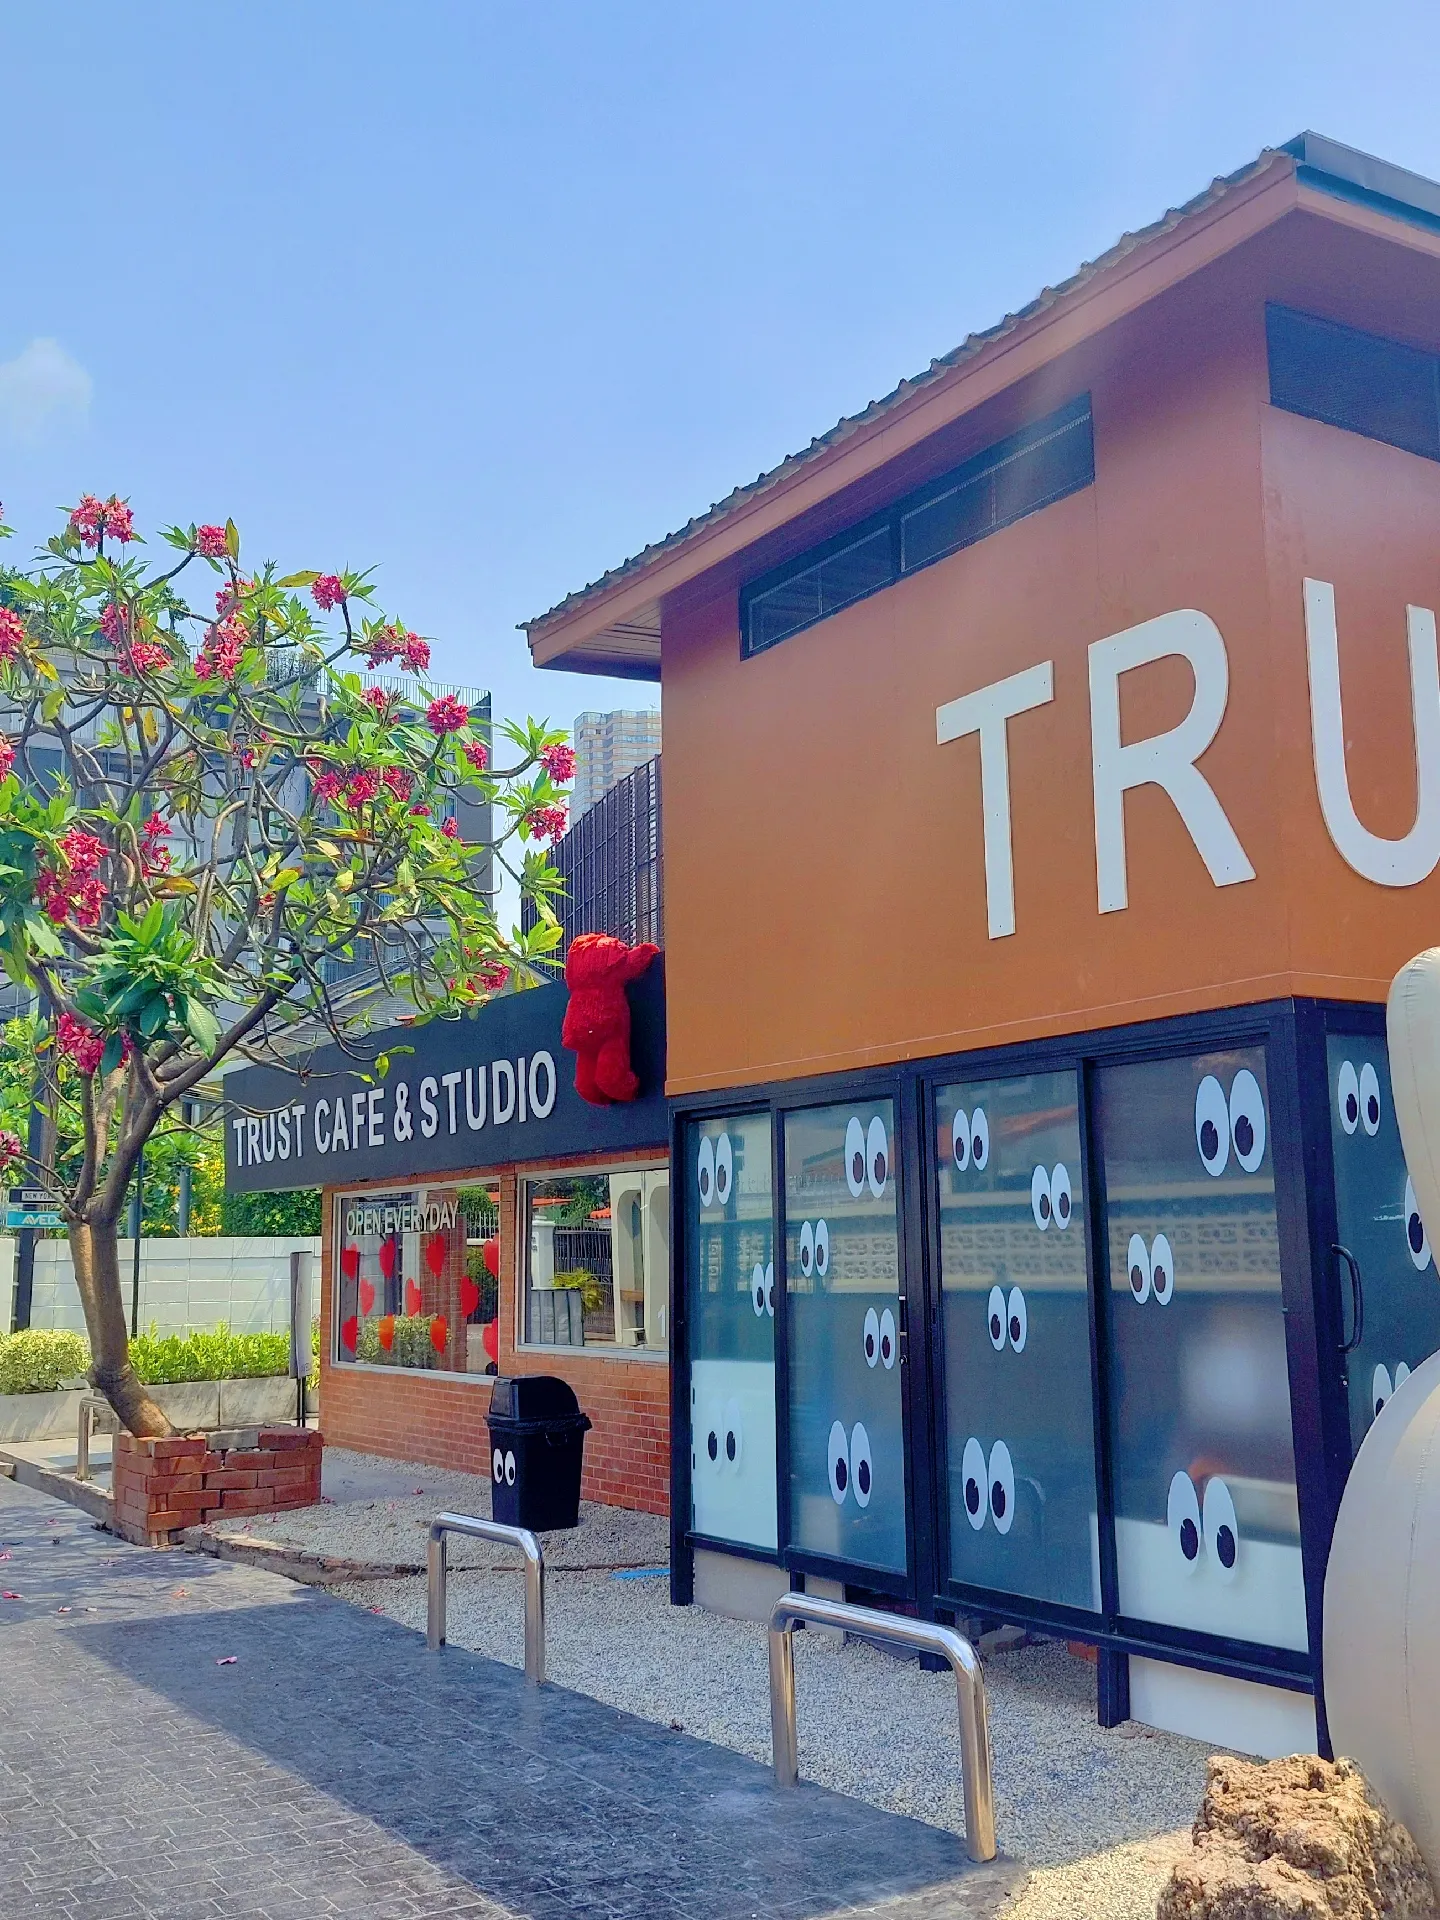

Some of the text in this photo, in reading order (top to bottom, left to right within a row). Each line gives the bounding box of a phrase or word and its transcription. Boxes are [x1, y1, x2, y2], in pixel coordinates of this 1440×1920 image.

[936, 577, 1440, 940] TRU
[233, 1050, 556, 1167] TRUST CAFE & STUDIO
[346, 1200, 459, 1235] OPEN EVERYDAY
